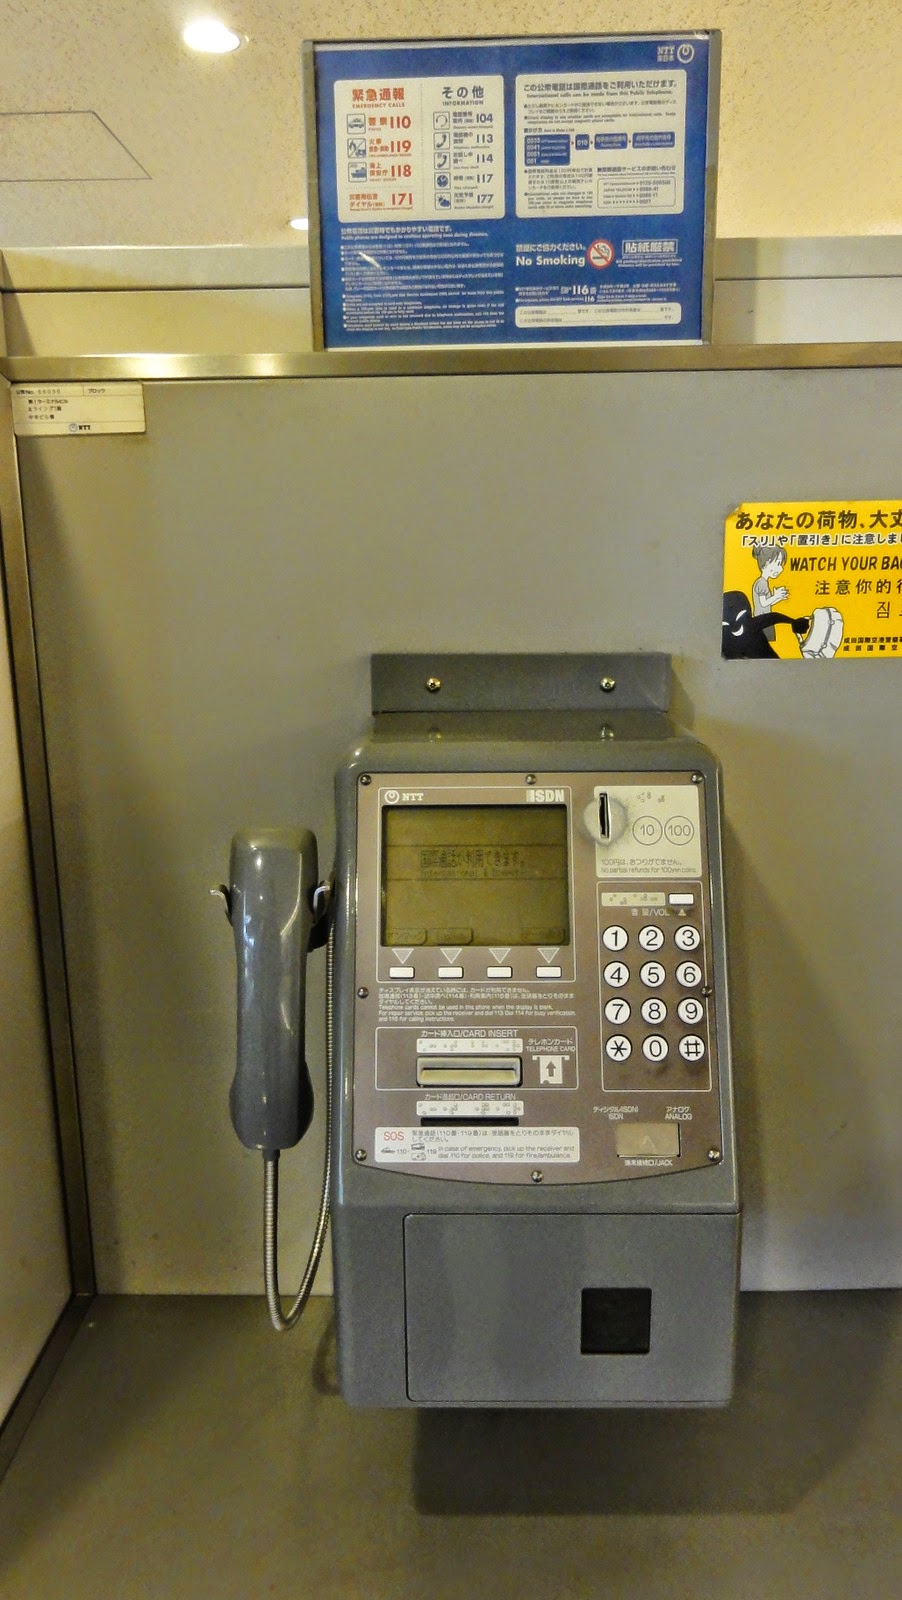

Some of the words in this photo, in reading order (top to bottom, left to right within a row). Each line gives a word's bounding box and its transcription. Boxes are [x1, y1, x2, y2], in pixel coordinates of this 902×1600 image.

[352, 88, 405, 101] 緊急通報
[442, 86, 484, 99] その他
[390, 115, 411, 129] 110
[476, 113, 493, 123] 104
[476, 134, 493, 143] 113
[390, 140, 412, 152] 119
[476, 154, 493, 163] 114
[391, 165, 412, 177] 118
[477, 174, 493, 183] 117
[392, 193, 413, 205] 171
[477, 194, 494, 203] 177
[516, 256, 532, 266] No
[536, 255, 585, 267] Smoking
[735, 509, 902, 530] あなたの荷物、大丈
[790, 557, 837, 571] WATCH
[842, 556, 877, 571] YOUR
[877, 602, 890, 619] 짐
[402, 793, 424, 801] NTT
[640, 824, 655, 836] 10
[668, 824, 691, 837] 100
[611, 930, 618, 946] 1
[646, 930, 658, 946] 2
[682, 930, 695, 946] 3
[610, 967, 623, 983] 4
[647, 966, 660, 984] 5
[683, 966, 696, 983] 6
[612, 1003, 624, 1020] 7
[648, 1003, 661, 1020] 8
[685, 1003, 698, 1020] 9
[488, 1029, 519, 1038] INSERT
[528, 1038, 574, 1046] テレホンカード
[649, 1040, 662, 1057] 0
[384, 1131, 404, 1141] SOS
